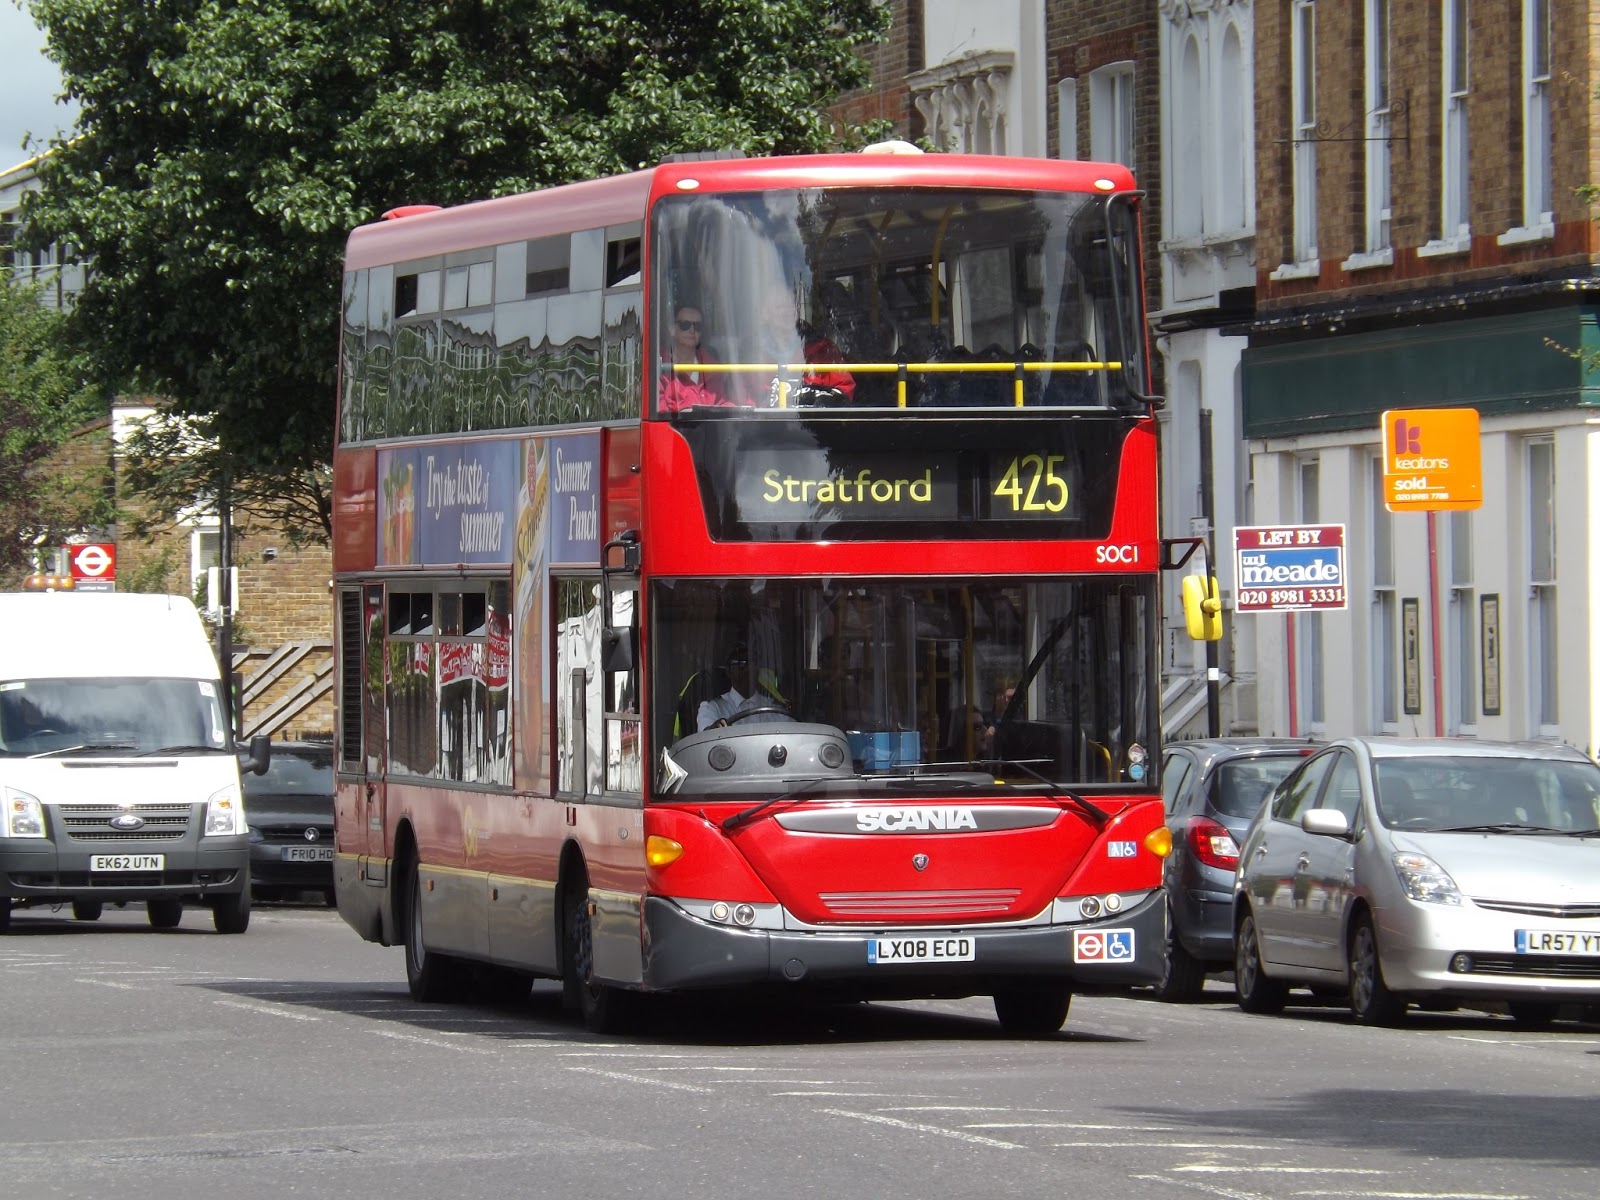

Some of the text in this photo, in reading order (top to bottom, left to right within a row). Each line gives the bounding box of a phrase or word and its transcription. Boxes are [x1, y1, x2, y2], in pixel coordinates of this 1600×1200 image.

[554, 447, 592, 493] Summer
[1395, 457, 1449, 469] keatons
[427, 456, 490, 520] Try the taste of
[762, 454, 1069, 512] Stratford 425
[1394, 477, 1427, 490] sold
[568, 495, 597, 541] Punch
[460, 511, 504, 553] summer
[1258, 530, 1322, 545] LET BY
[1243, 559, 1339, 583] meade
[1240, 589, 1343, 604] 020 8981 3331
[856, 807, 978, 831] SCANIA
[97, 857, 158, 869] EK62 UTN
[291, 849, 316, 860] FR10
[878, 940, 970, 959] LX08 ECD
[1530, 933, 1576, 951] LR57
